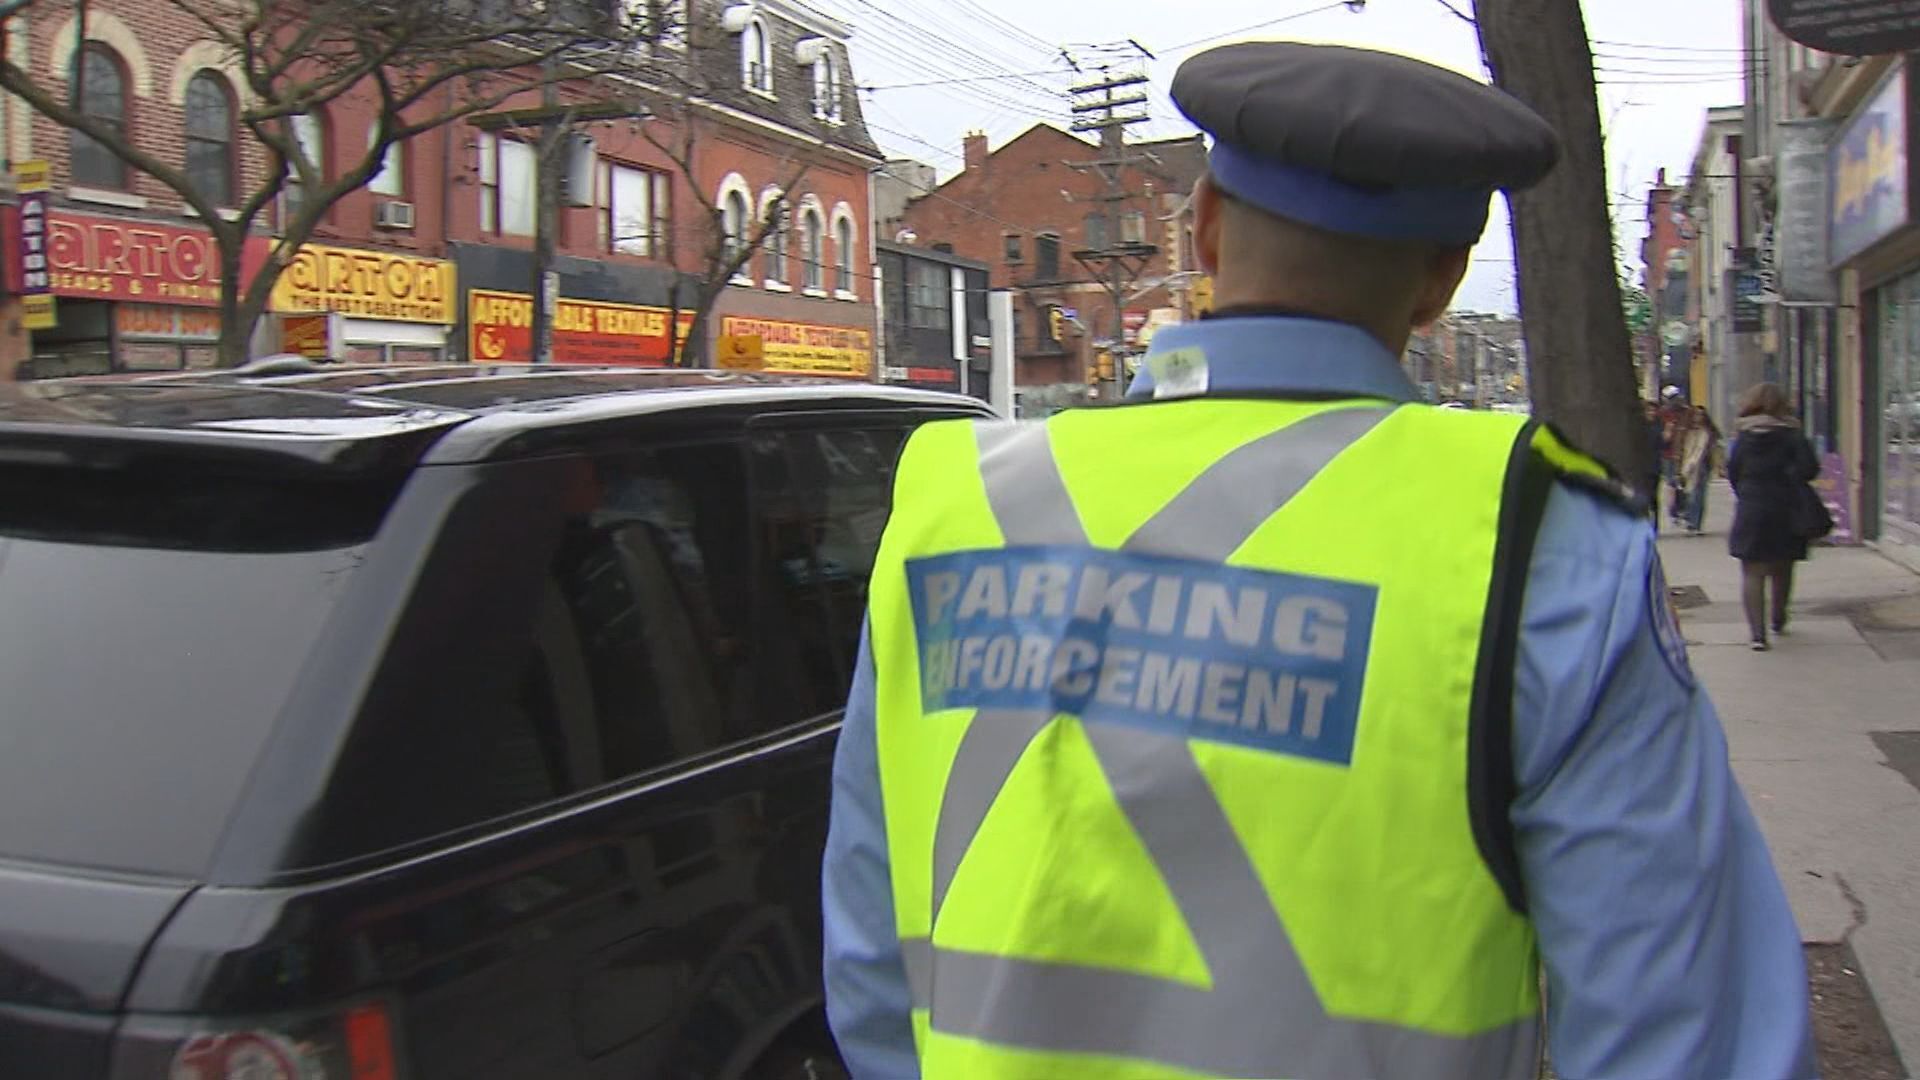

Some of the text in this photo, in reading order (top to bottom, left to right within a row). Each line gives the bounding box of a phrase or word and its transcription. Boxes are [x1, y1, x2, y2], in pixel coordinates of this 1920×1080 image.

[129, 280, 143, 295] &
[923, 562, 1349, 663] PARKING
[925, 633, 1338, 741] ENFORCEMENT
